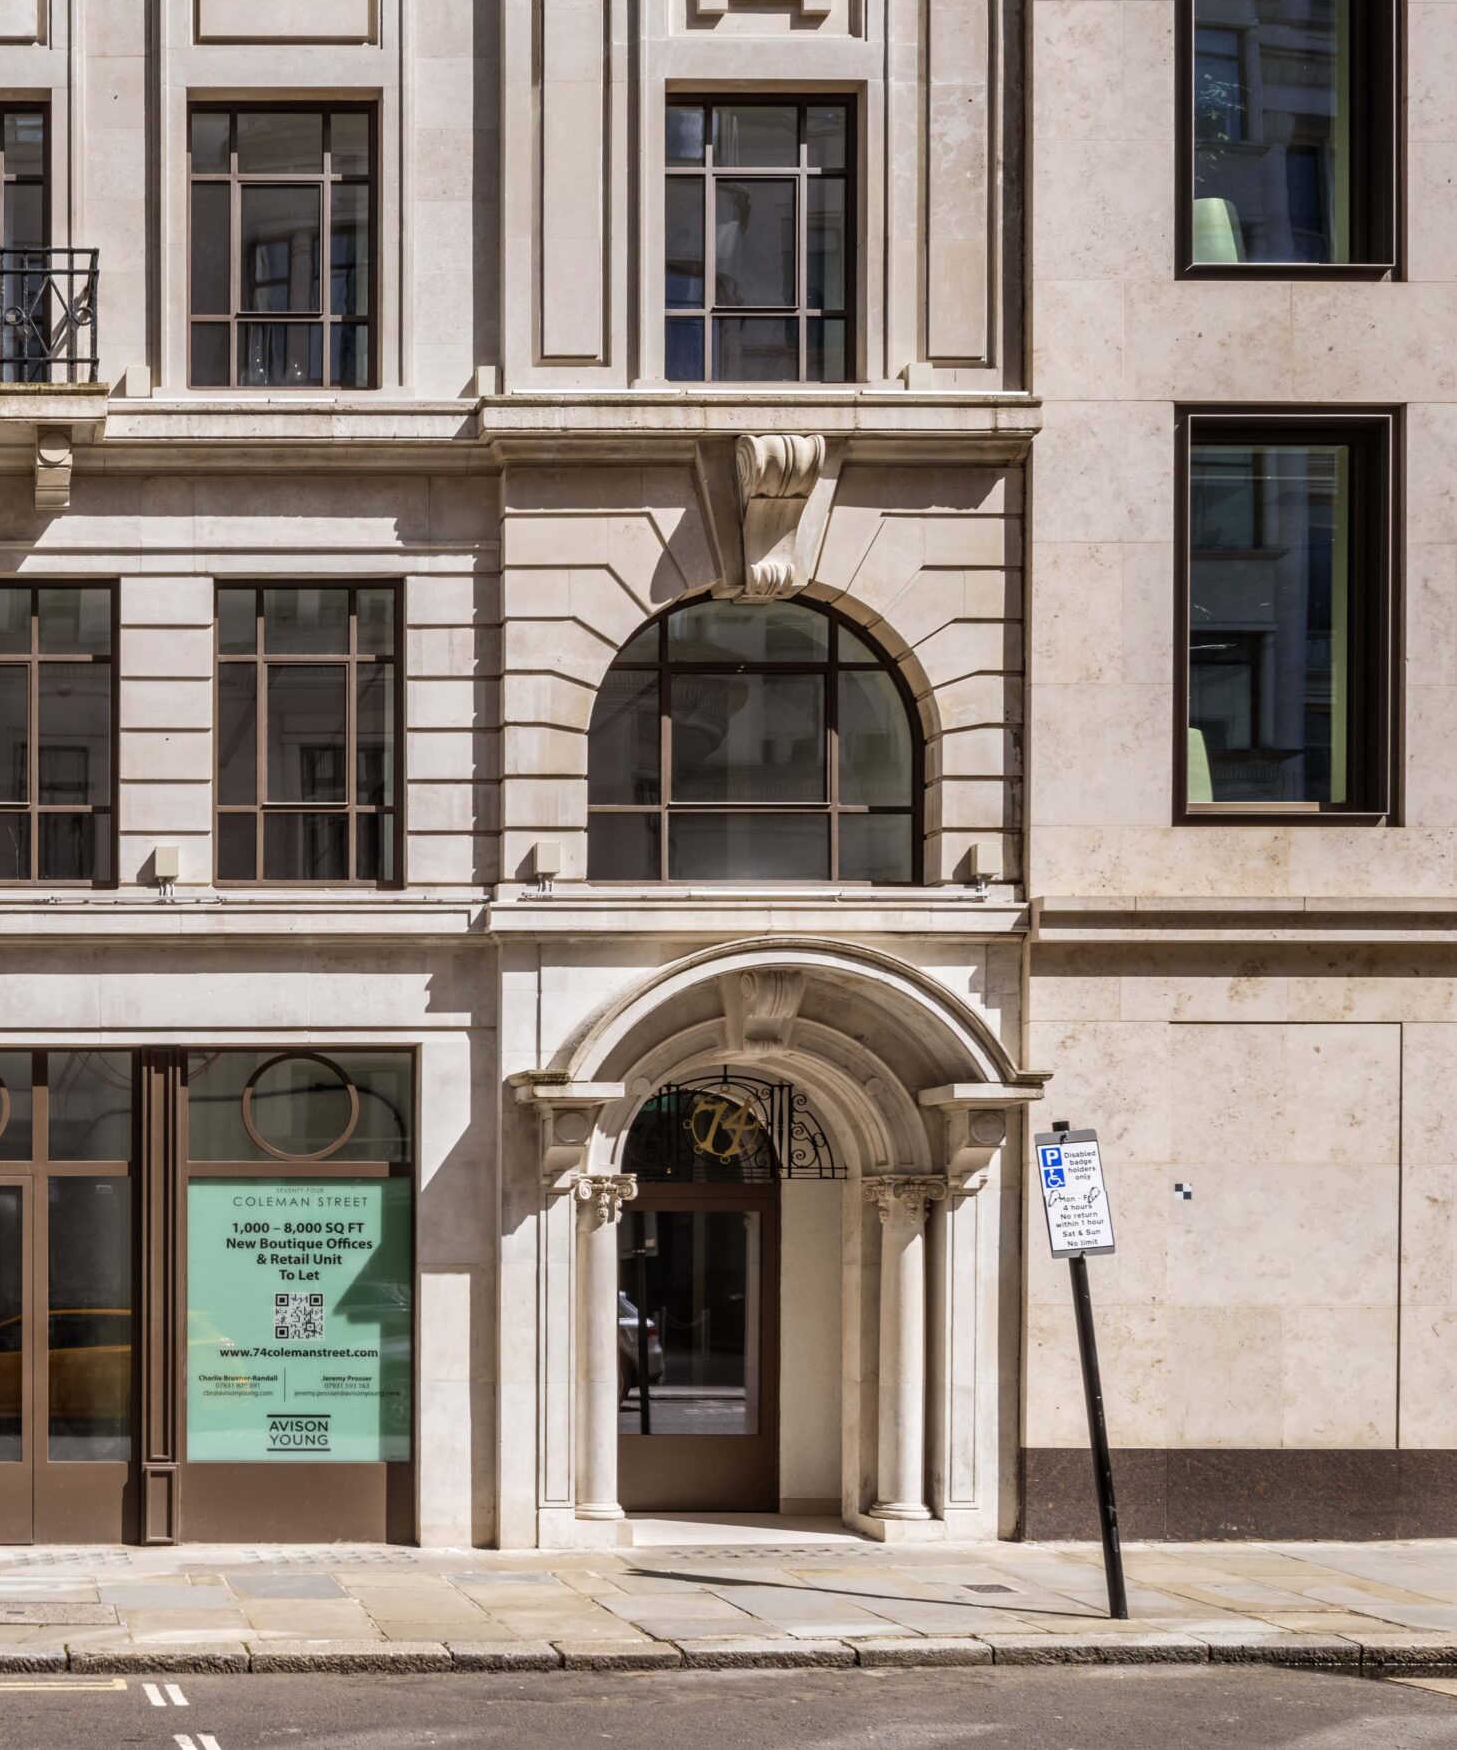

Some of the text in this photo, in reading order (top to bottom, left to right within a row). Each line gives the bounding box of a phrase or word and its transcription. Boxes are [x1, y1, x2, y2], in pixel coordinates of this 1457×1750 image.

[693, 1098, 757, 1155] 74
[1045, 1149, 1059, 1166] P
[1064, 1150, 1096, 1158] Disabled
[232, 1197, 368, 1207] COLEMAN STREET
[1070, 1203, 1092, 1211] hours
[232, 1222, 270, 1235] 1,000
[283, 1222, 322, 1235] 8,000
[325, 1222, 344, 1235] SQ
[347, 1222, 365, 1233] FT
[1062, 1230, 1076, 1238] Sat
[226, 1237, 373, 1252] New Boutique Offices
[256, 1253, 343, 1265] & Retail Unit
[279, 1269, 320, 1281] To Let
[220, 1347, 379, 1357] www.74colemanstreet.com
[269, 1420, 328, 1432] AVISON
[269, 1434, 328, 1446] YOUNG
